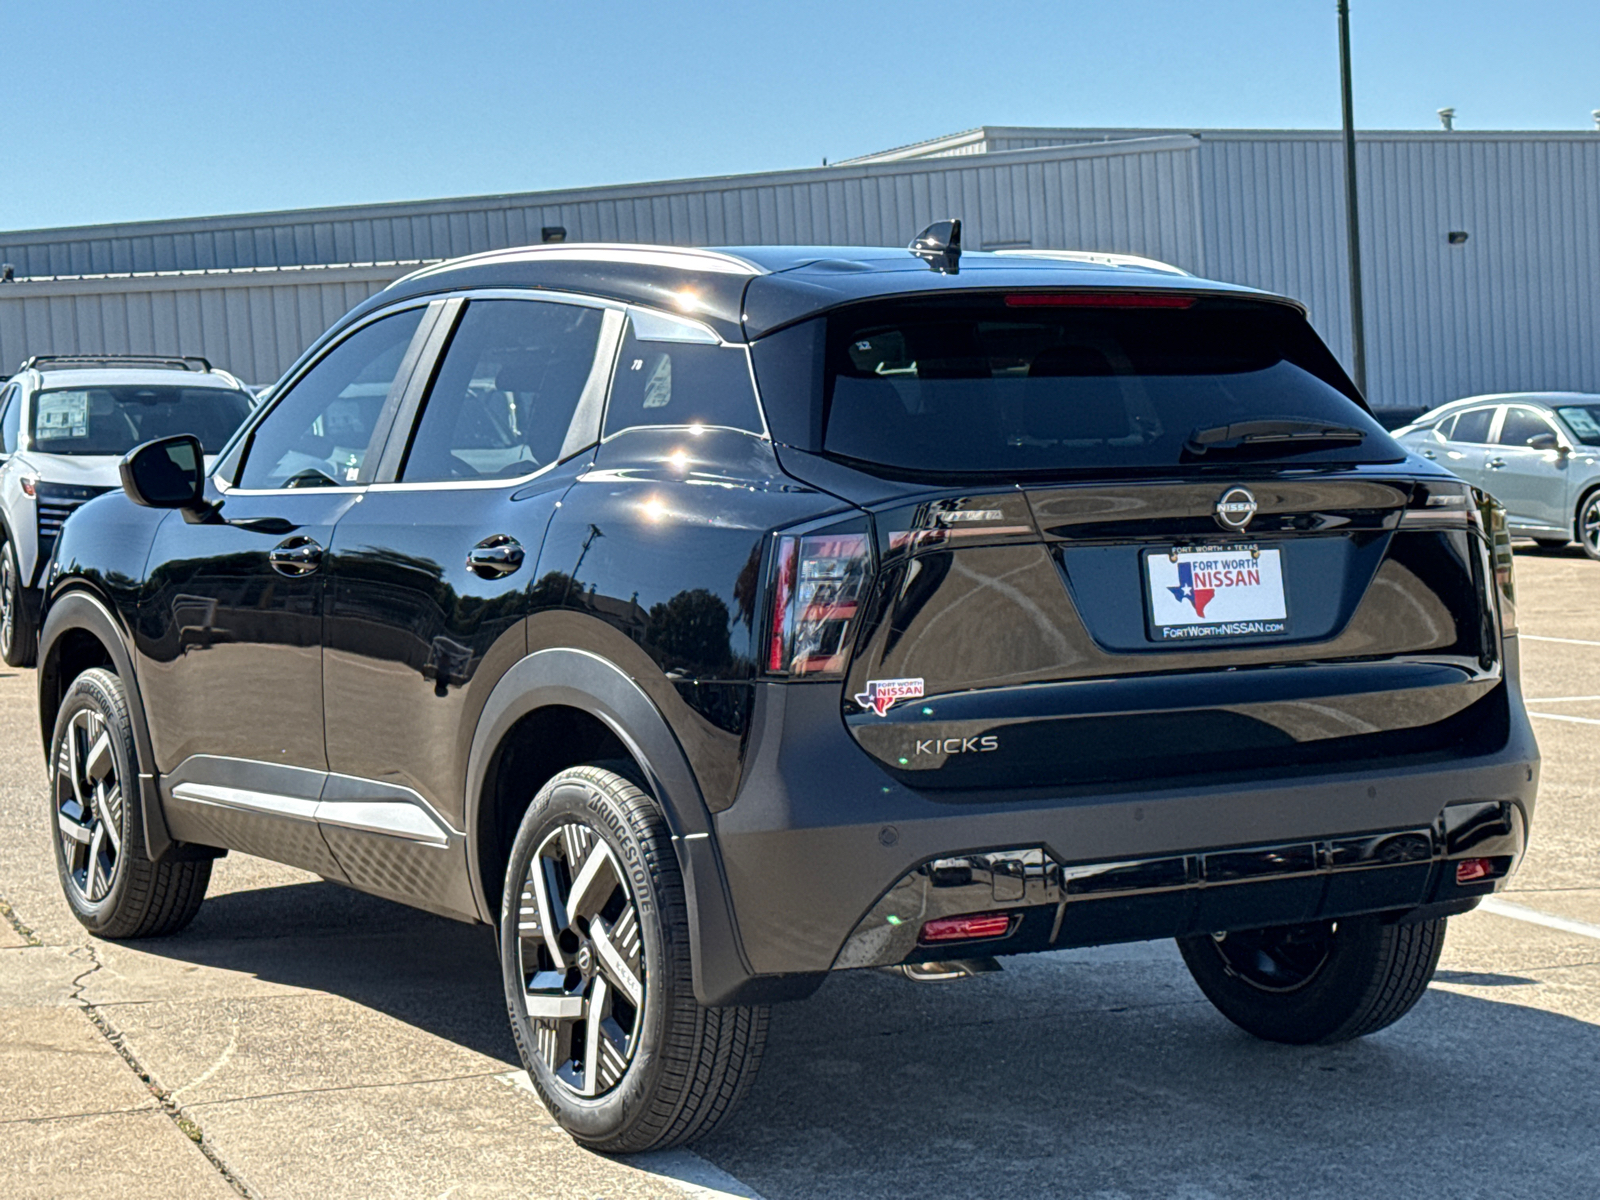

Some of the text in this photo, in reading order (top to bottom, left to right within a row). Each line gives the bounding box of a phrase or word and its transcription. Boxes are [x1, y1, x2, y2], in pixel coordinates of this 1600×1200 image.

[1217, 503, 1257, 512] NISSAN
[1172, 546, 1192, 554] FORT
[1192, 558, 1259, 571] FORT WORTH
[1193, 569, 1261, 588] NISSAN
[877, 686, 923, 696] NISSAN
[75, 681, 114, 719] BRIDGESTONE
[916, 736, 998, 755] KICKS
[588, 791, 654, 914] BRIDGESTONE
